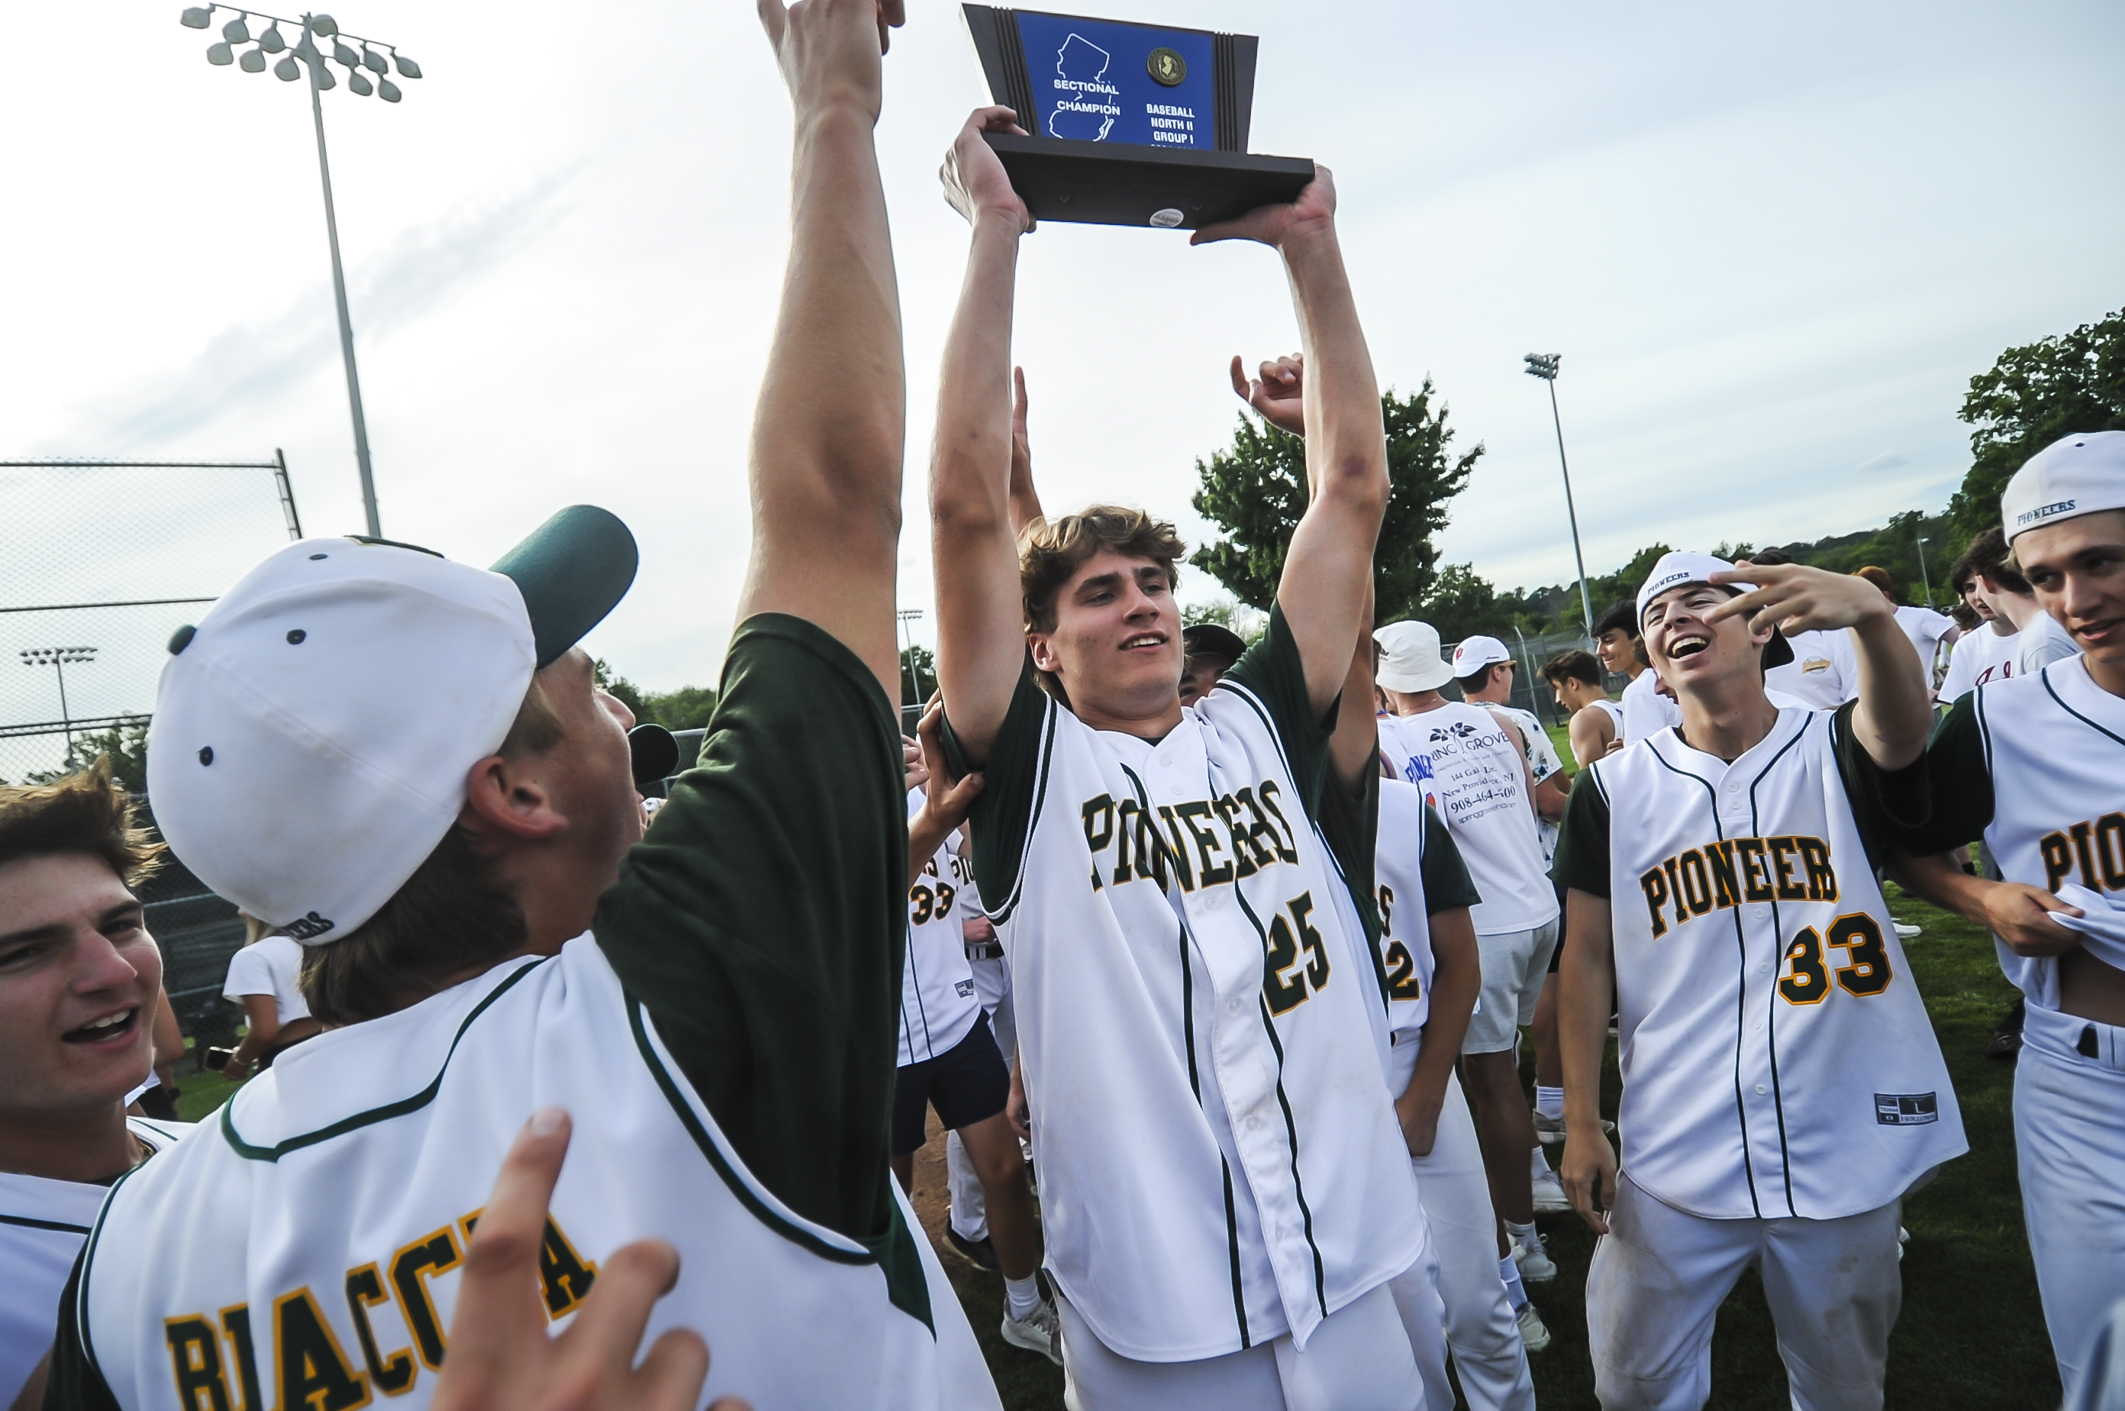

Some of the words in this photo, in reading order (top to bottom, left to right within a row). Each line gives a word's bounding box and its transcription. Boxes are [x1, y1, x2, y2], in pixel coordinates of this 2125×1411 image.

[1053, 79, 1119, 95] SECTIONAL
[1057, 100, 1120, 116] CHAMPION
[1146, 103, 1195, 118] BASEBALL
[1151, 117, 1184, 130] NORTH
[1153, 131, 1188, 143] GROUP
[1190, 134, 1194, 144] I
[2017, 499, 2076, 526] PIONEERS
[1647, 571, 1690, 595] PIONEERS
[1639, 836, 1841, 940] PIONEER
[909, 882, 956, 926] 33
[1261, 890, 1331, 1018] 25
[1778, 911, 1893, 1006] 33
